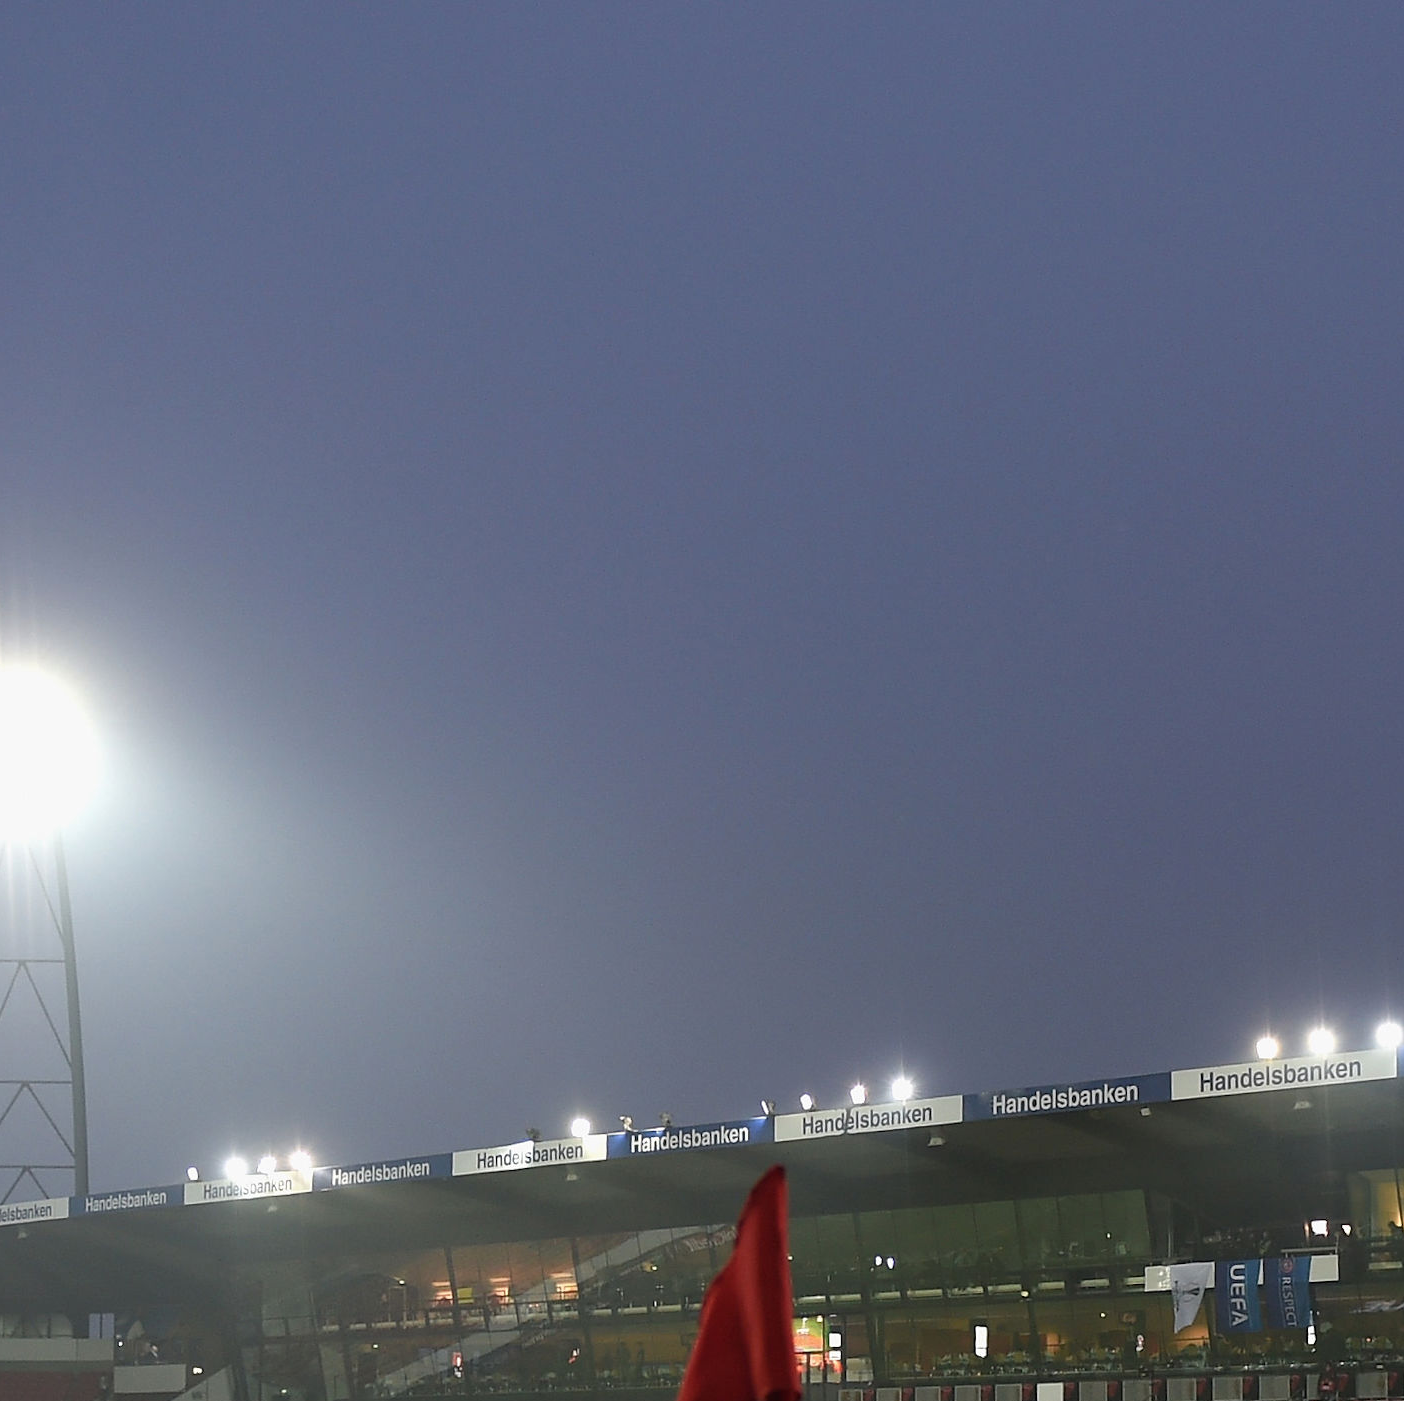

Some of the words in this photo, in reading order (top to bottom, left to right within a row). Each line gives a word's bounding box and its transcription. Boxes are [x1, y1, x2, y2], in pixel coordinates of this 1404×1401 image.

[1200, 1058, 1362, 1093] Handelsbanken
[993, 1083, 1139, 1116] Handelsbanken
[802, 1105, 933, 1135] Handelsbanken
[630, 1124, 749, 1154] Handelsbanken
[477, 1143, 583, 1170] Handelsbanken
[332, 1160, 430, 1187] Handelsbanken
[85, 1190, 167, 1213] Handelsbanken
[1229, 1263, 1248, 1327] UEFA
[1281, 1276, 1297, 1328] RESPECT
